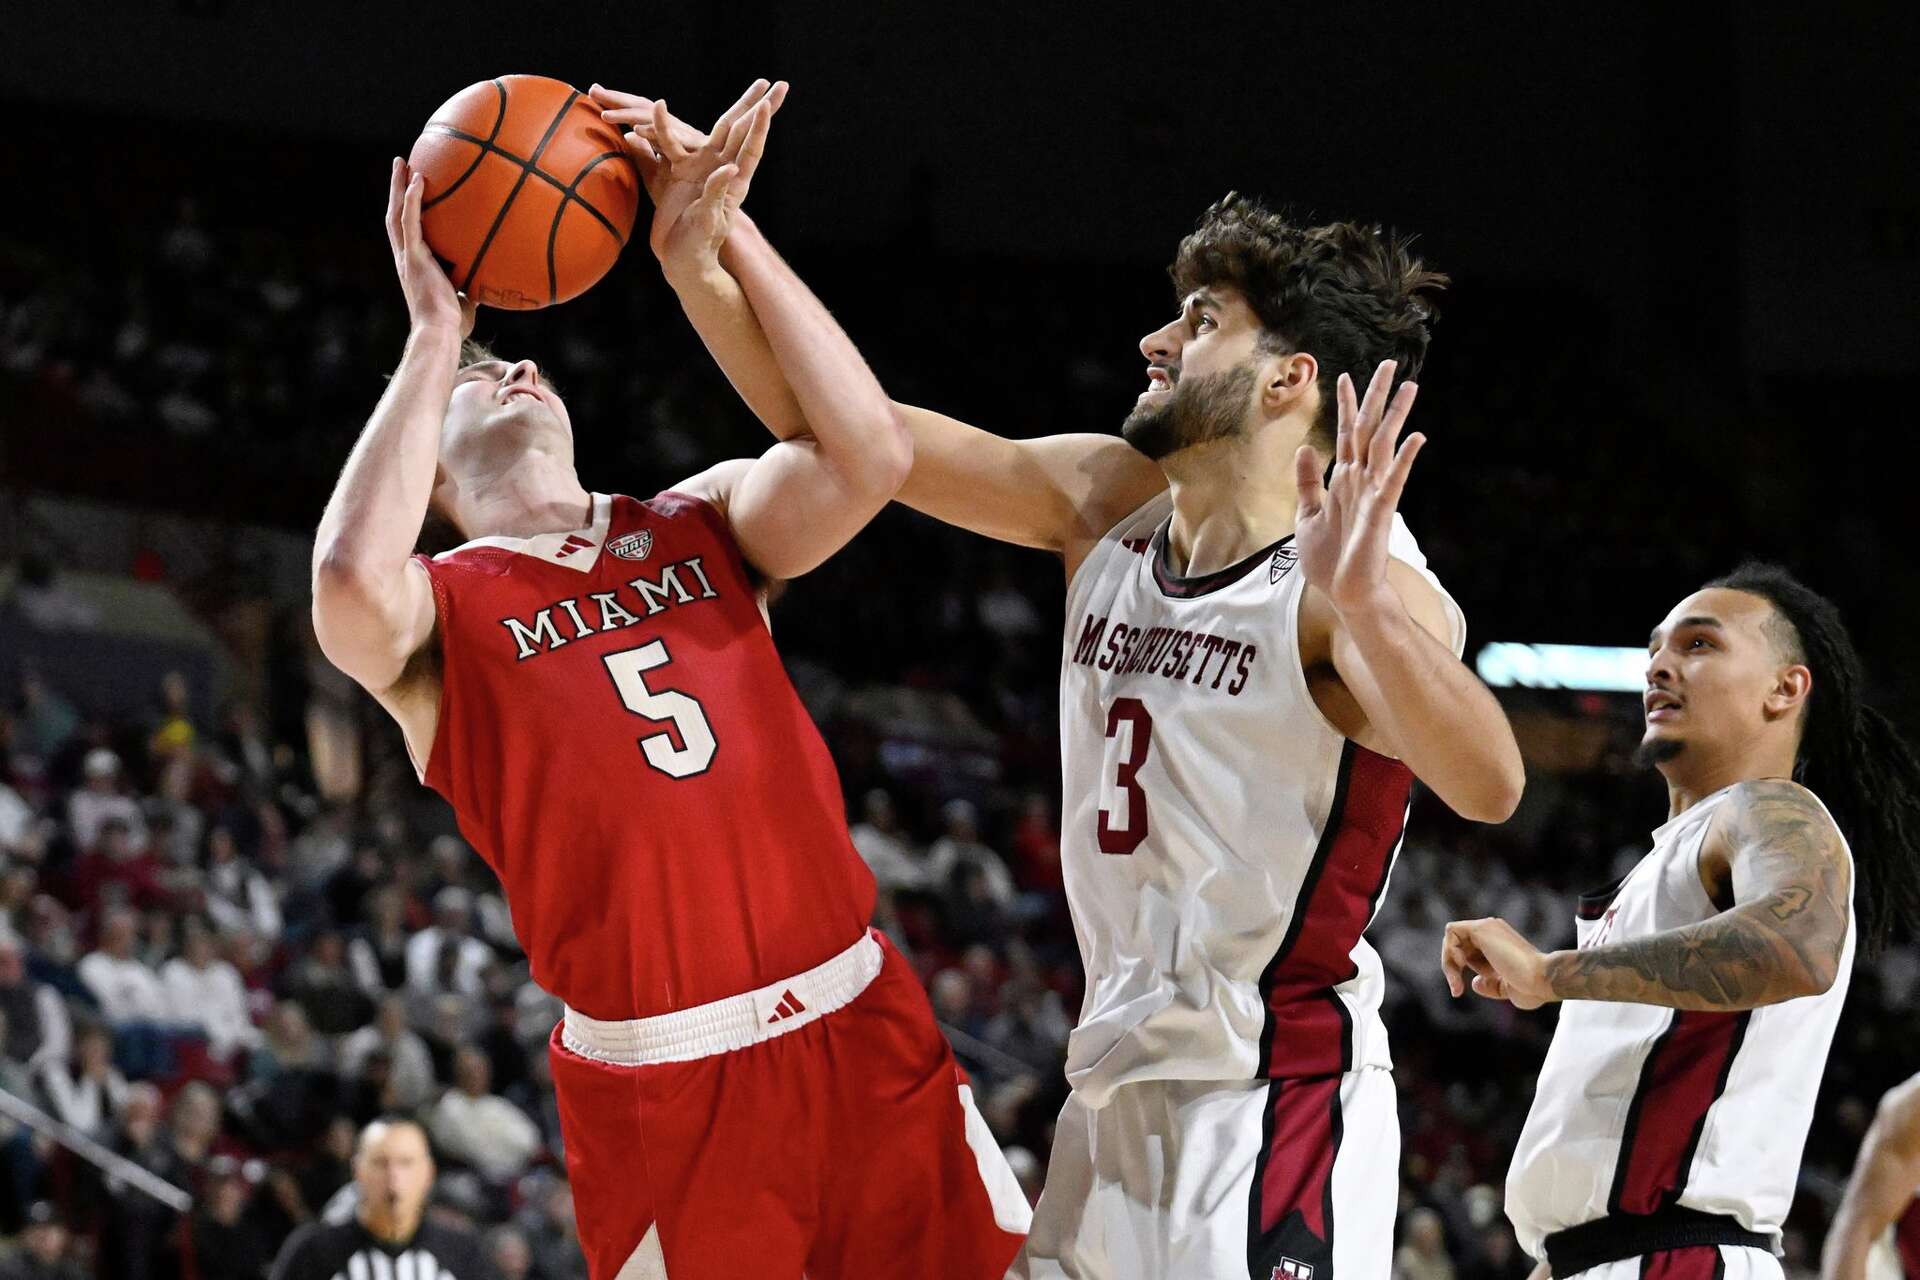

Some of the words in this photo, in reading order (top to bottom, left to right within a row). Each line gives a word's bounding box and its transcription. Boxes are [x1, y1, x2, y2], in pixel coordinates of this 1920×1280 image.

[501, 557, 718, 660] MIAMI
[602, 637, 719, 779] 5
[1097, 697, 1152, 855] 3
